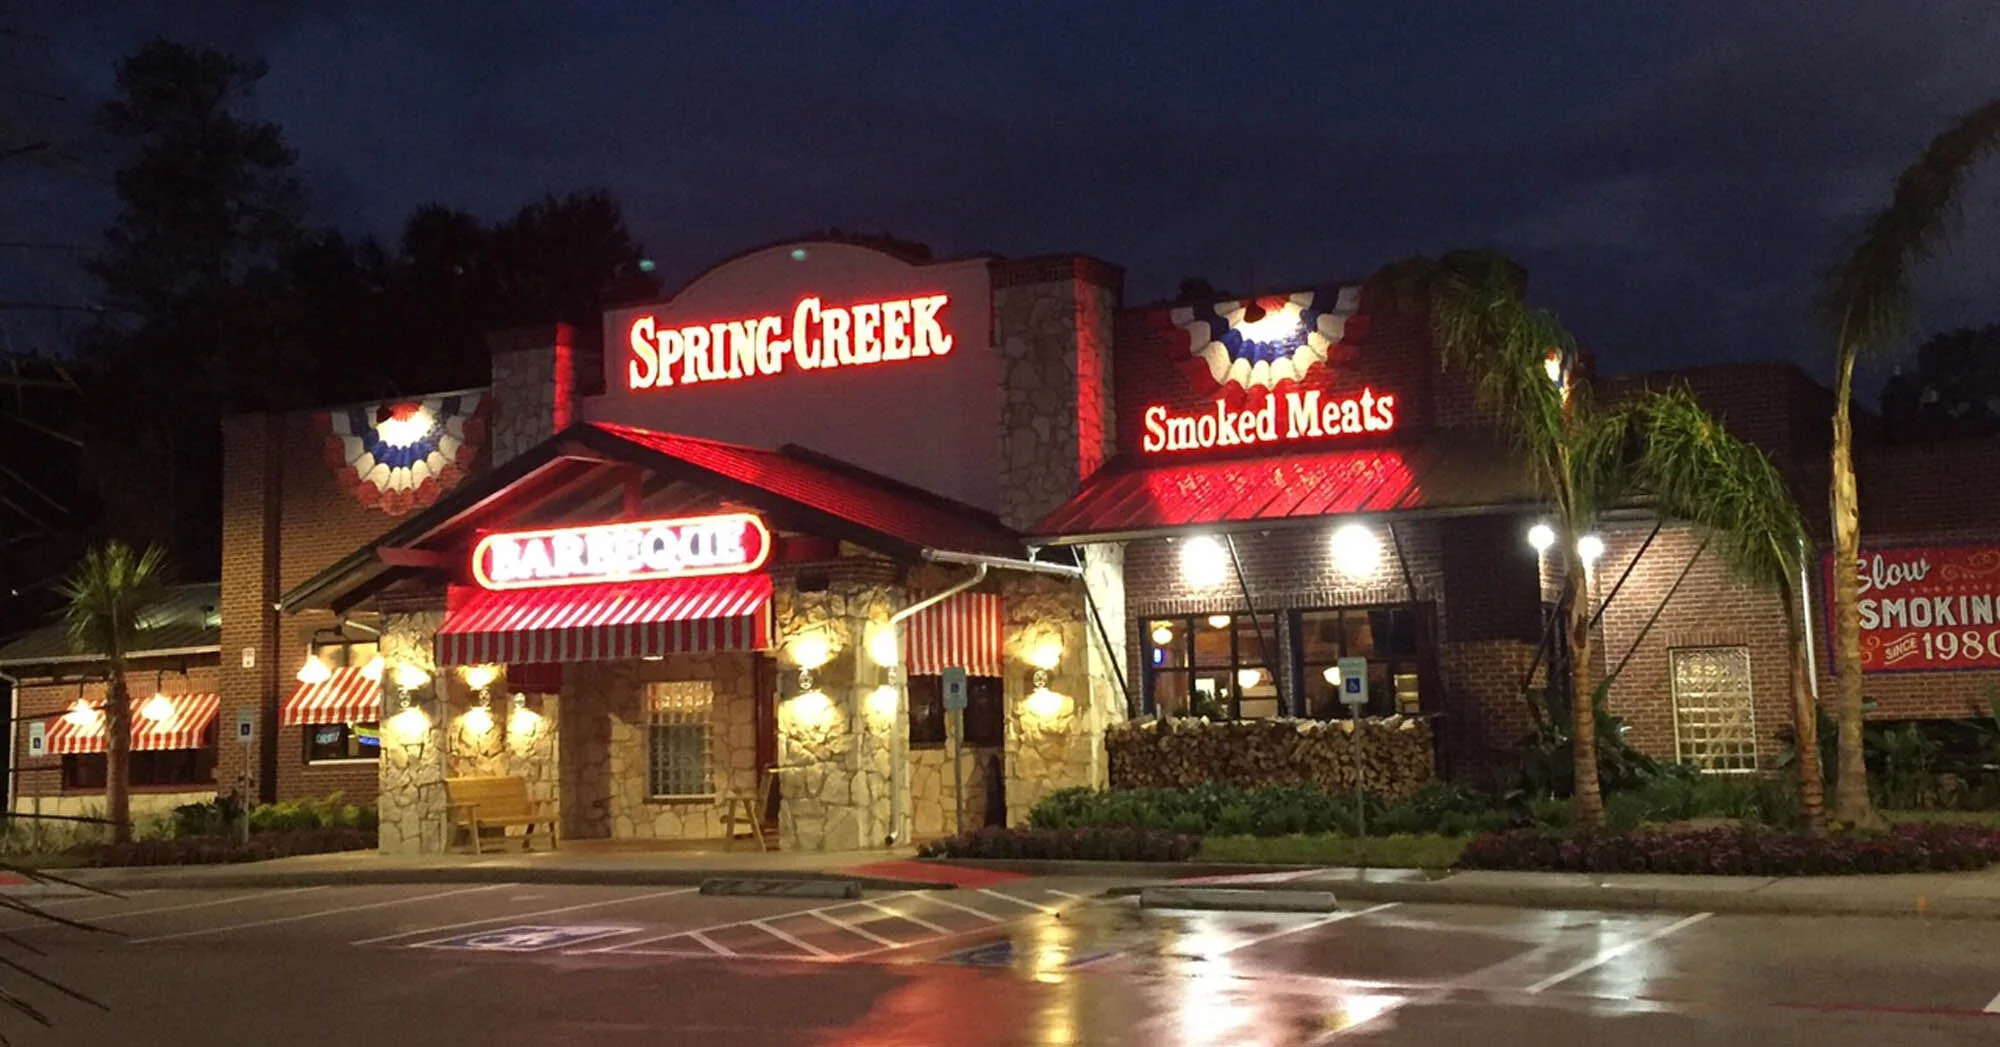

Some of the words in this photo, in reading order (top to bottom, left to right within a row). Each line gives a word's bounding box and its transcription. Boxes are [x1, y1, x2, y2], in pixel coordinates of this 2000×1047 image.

[630, 316, 791, 389] SPRING
[793, 296, 953, 369] CREEK
[1144, 393, 1277, 452] Smoked
[1285, 387, 1394, 438] Meats
[490, 520, 747, 582] BARBEQUE
[1857, 594, 2000, 630] SMOKIN
[1885, 637, 1918, 660] SINCE
